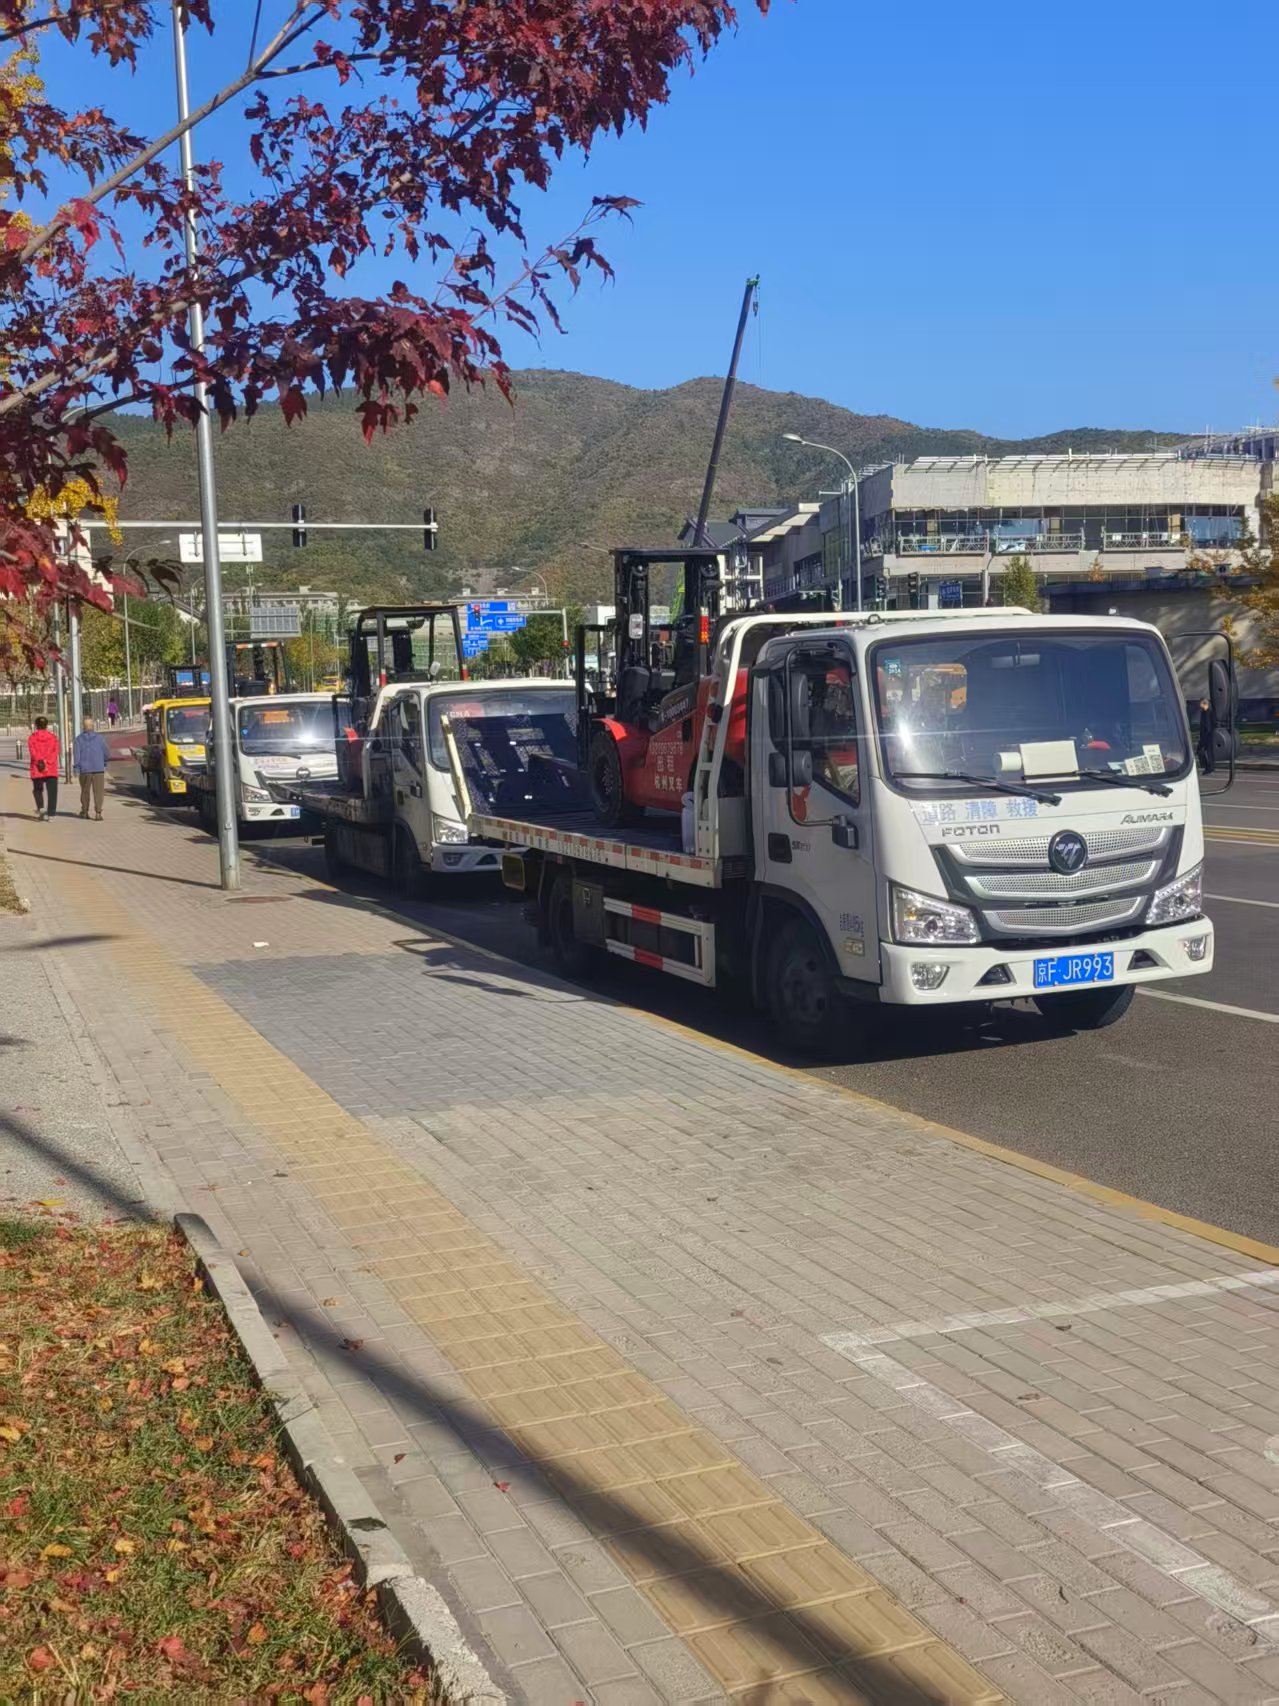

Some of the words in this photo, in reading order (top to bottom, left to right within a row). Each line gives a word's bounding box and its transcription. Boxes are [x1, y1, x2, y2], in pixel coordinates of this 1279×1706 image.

[964, 800, 998, 820] 清障
[1006, 798, 1039, 818] 救援
[941, 824, 1001, 838] FOTON
